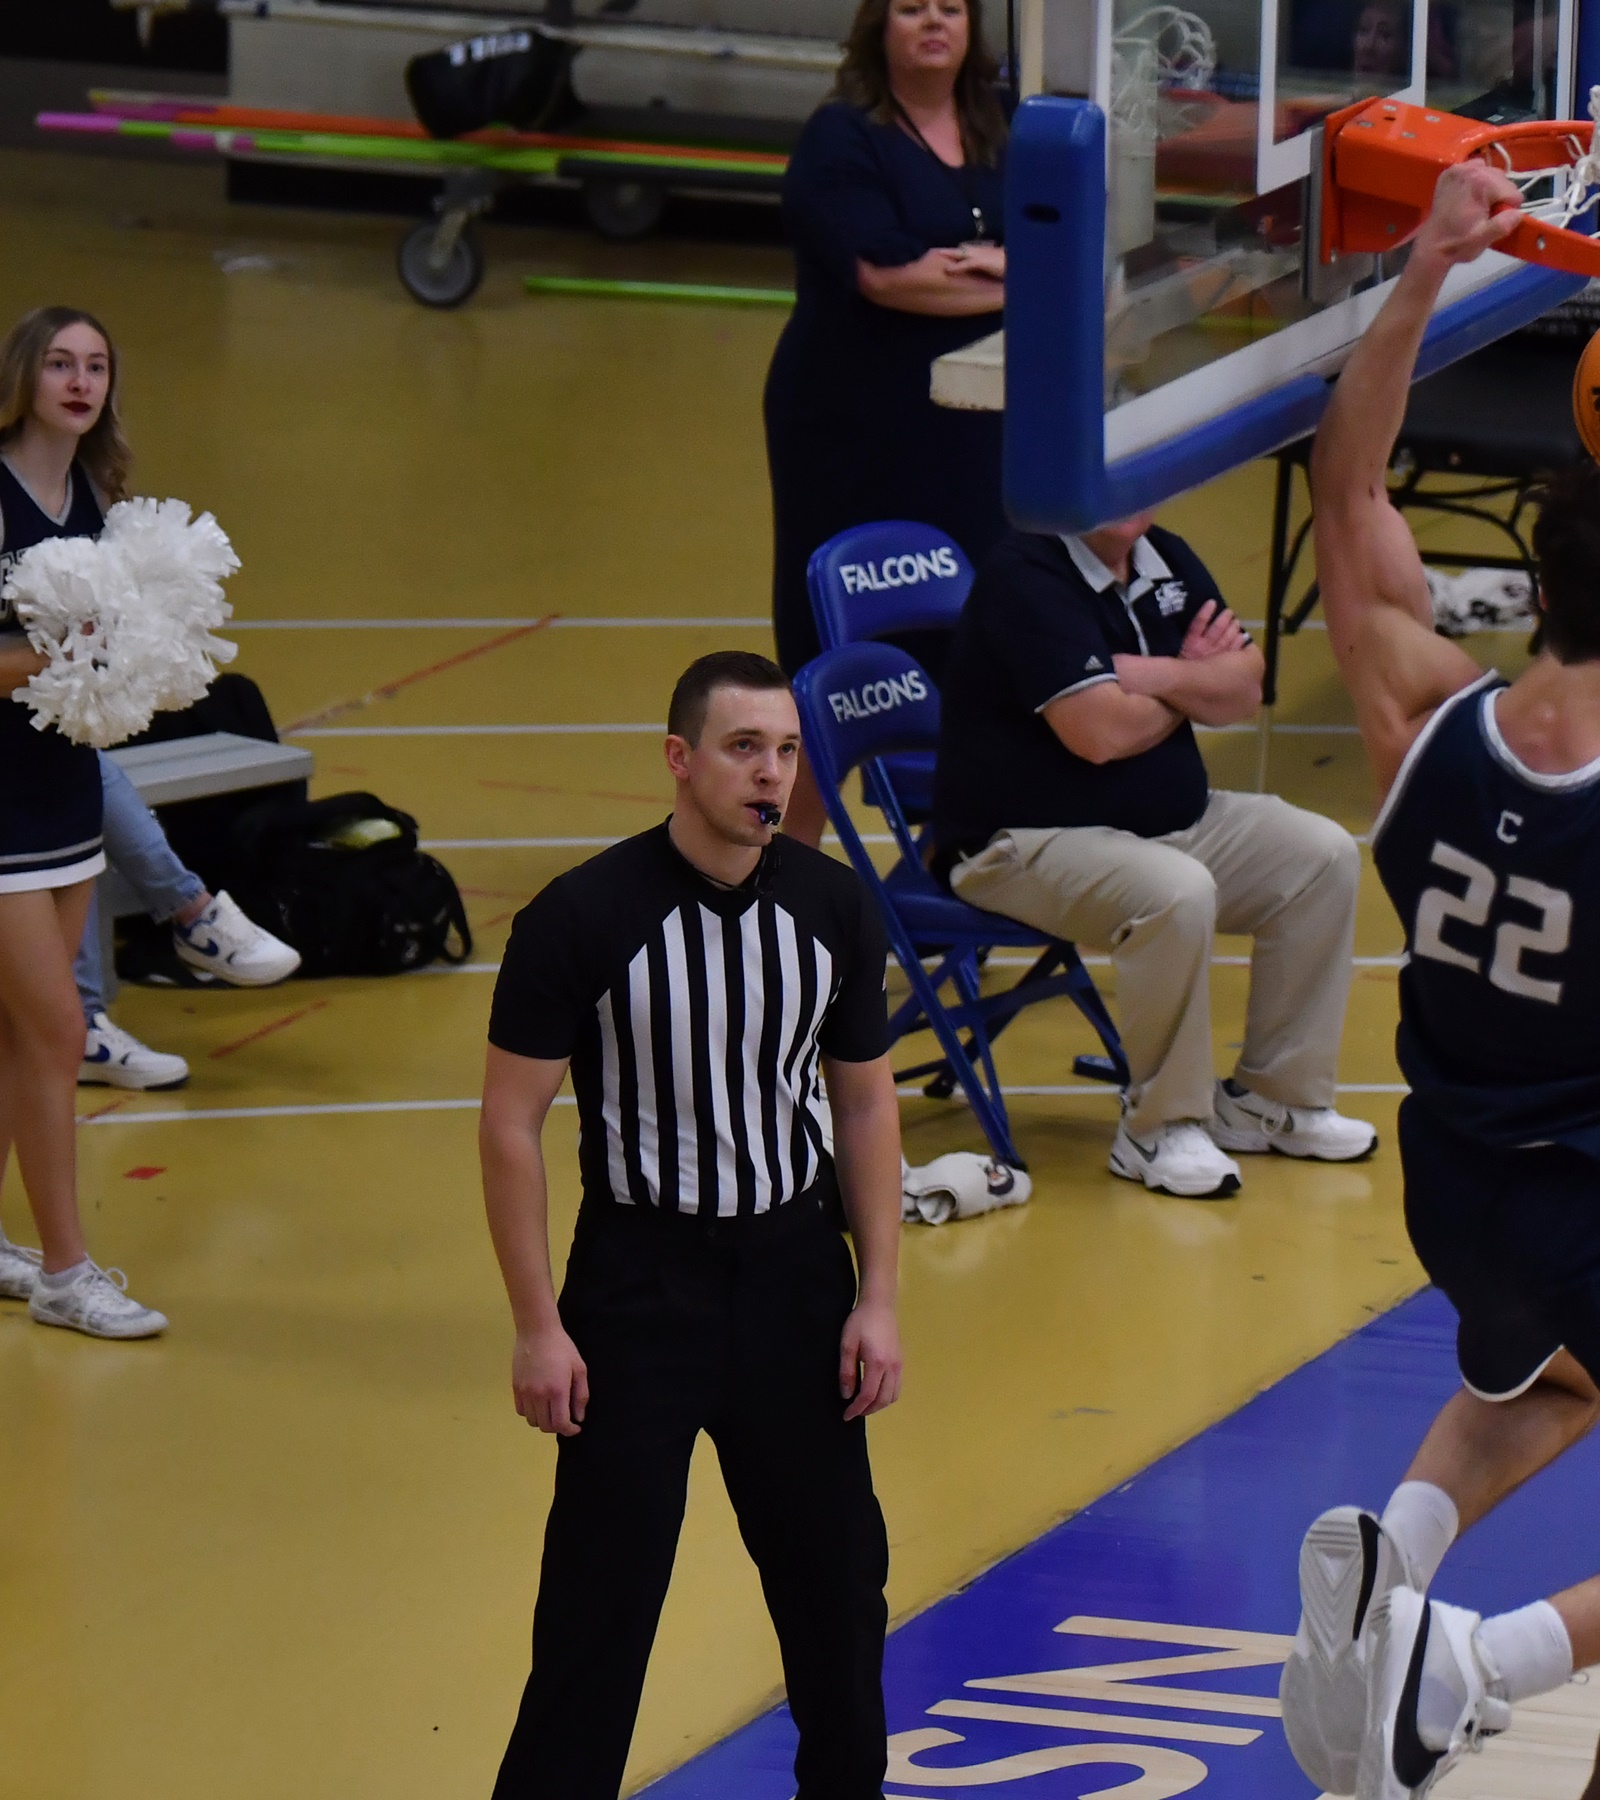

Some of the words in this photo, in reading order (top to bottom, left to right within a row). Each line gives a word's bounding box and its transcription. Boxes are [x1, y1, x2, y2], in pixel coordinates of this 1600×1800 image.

[839, 547, 959, 595] FALCONS
[828, 670, 927, 723] FALCONS
[1496, 810, 1523, 844] C
[1414, 839, 1572, 1005] 22
[886, 1615, 1295, 1800] SIN
